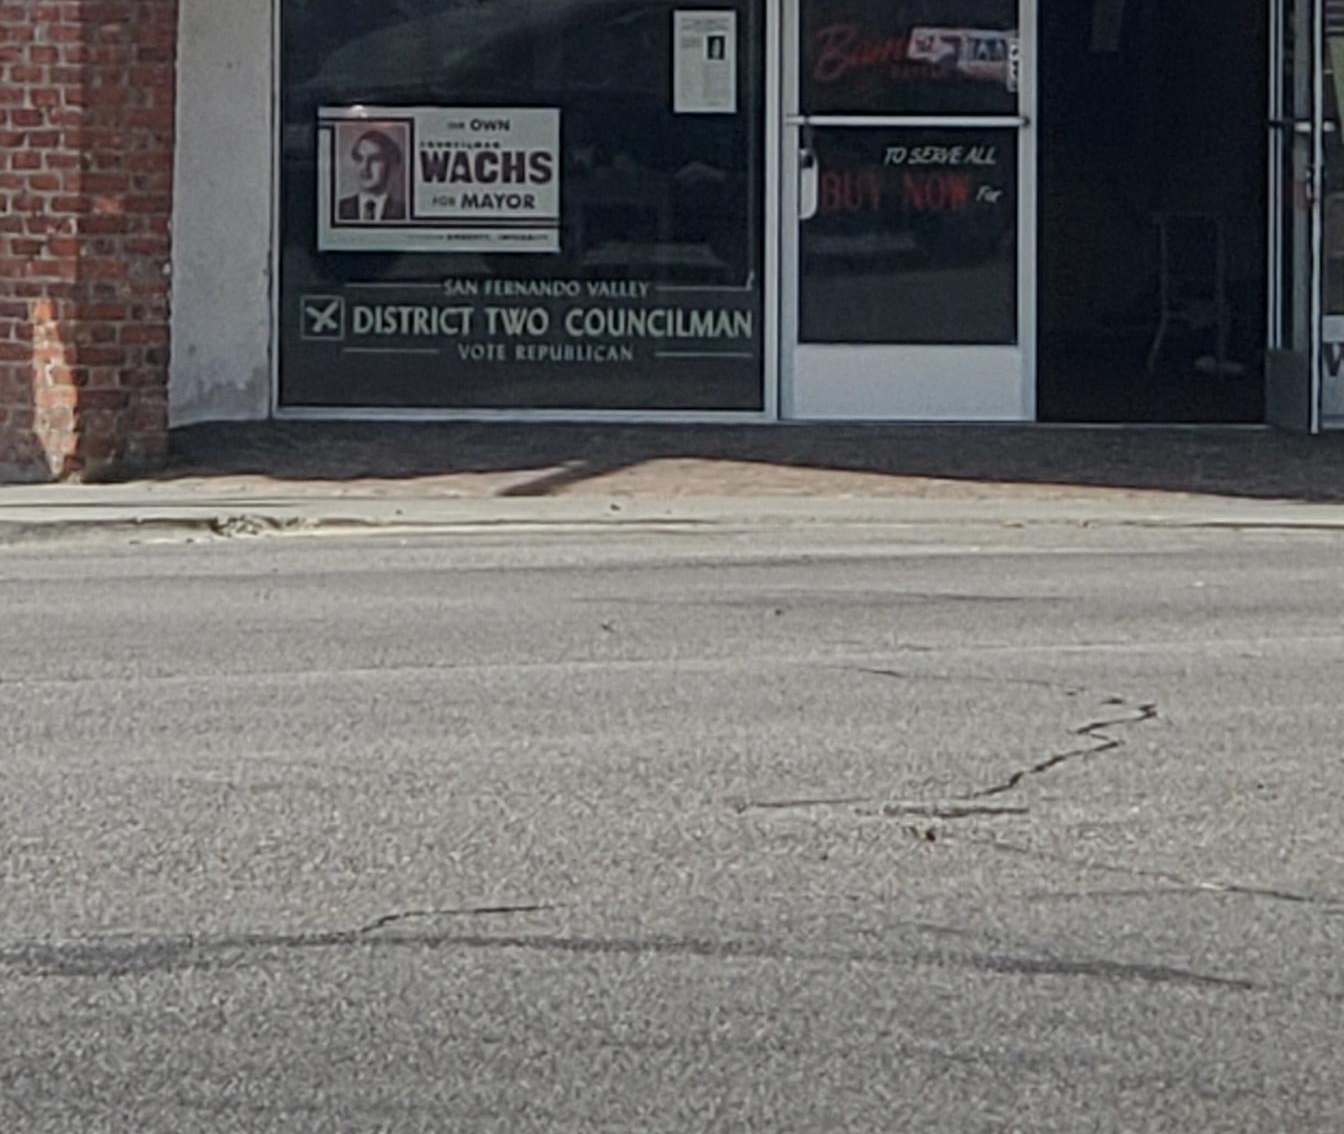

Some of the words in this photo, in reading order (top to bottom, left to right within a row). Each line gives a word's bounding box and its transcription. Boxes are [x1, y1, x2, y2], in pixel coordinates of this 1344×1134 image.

[470, 117, 511, 132] OWN
[883, 146, 906, 165] TO
[908, 145, 963, 165] SERVE
[964, 145, 997, 165] ALL
[420, 150, 553, 185] WACHS
[461, 192, 536, 210] MAYOR
[822, 170, 881, 211] BUY
[903, 170, 971, 211] NOW
[443, 278, 479, 297] SAN
[485, 279, 581, 298] FERNANDO
[587, 281, 650, 299] VALLEY
[354, 305, 476, 337] DISTRICT
[484, 307, 550, 337] TWO
[565, 307, 753, 339] COUNCILMAN
[458, 342, 506, 362] VOTE
[515, 343, 634, 363] REPUBLICAN
